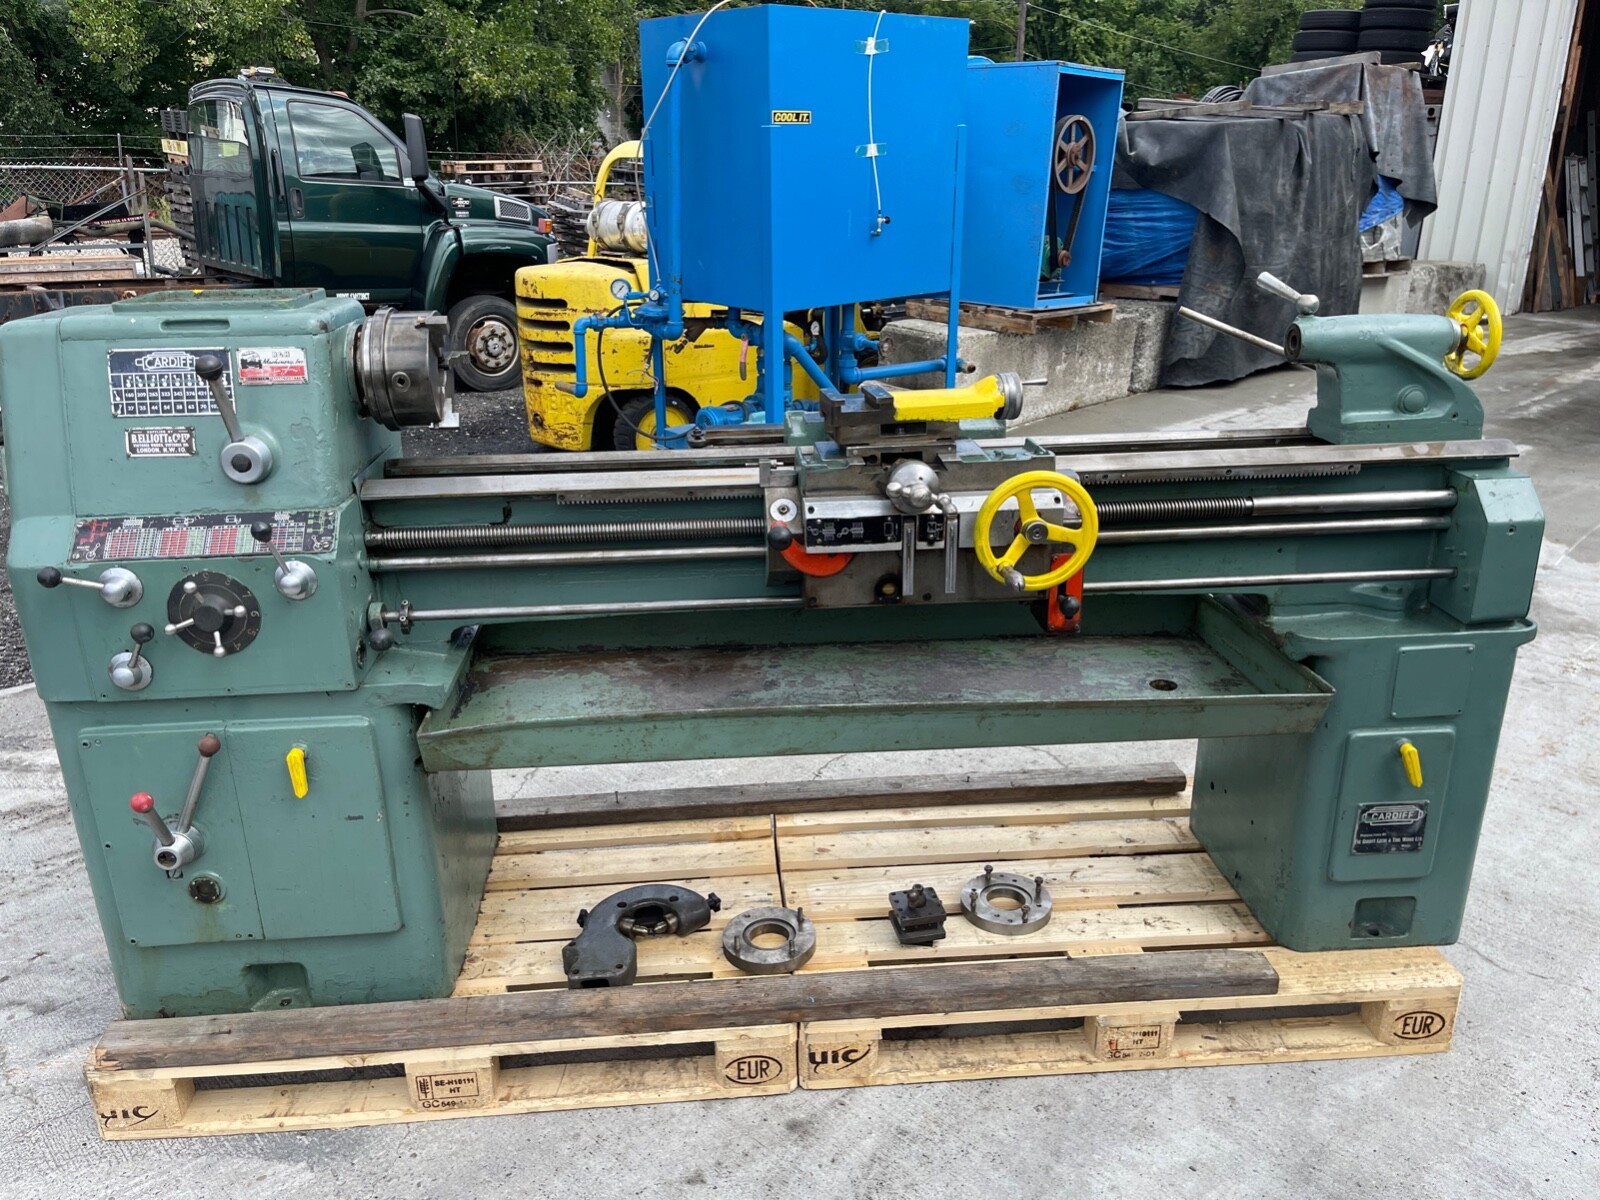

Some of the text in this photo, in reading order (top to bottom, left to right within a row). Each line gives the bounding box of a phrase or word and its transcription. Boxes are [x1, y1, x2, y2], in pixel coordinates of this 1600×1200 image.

[775, 112, 797, 122] COOL
[145, 356, 193, 369] CARDIFF
[1371, 811, 1415, 820] CARDIFF
[1401, 1015, 1435, 1035] EUR
[736, 1059, 770, 1080] EUR
[449, 1086, 461, 1094] HT
[422, 1099, 440, 1109] GC
